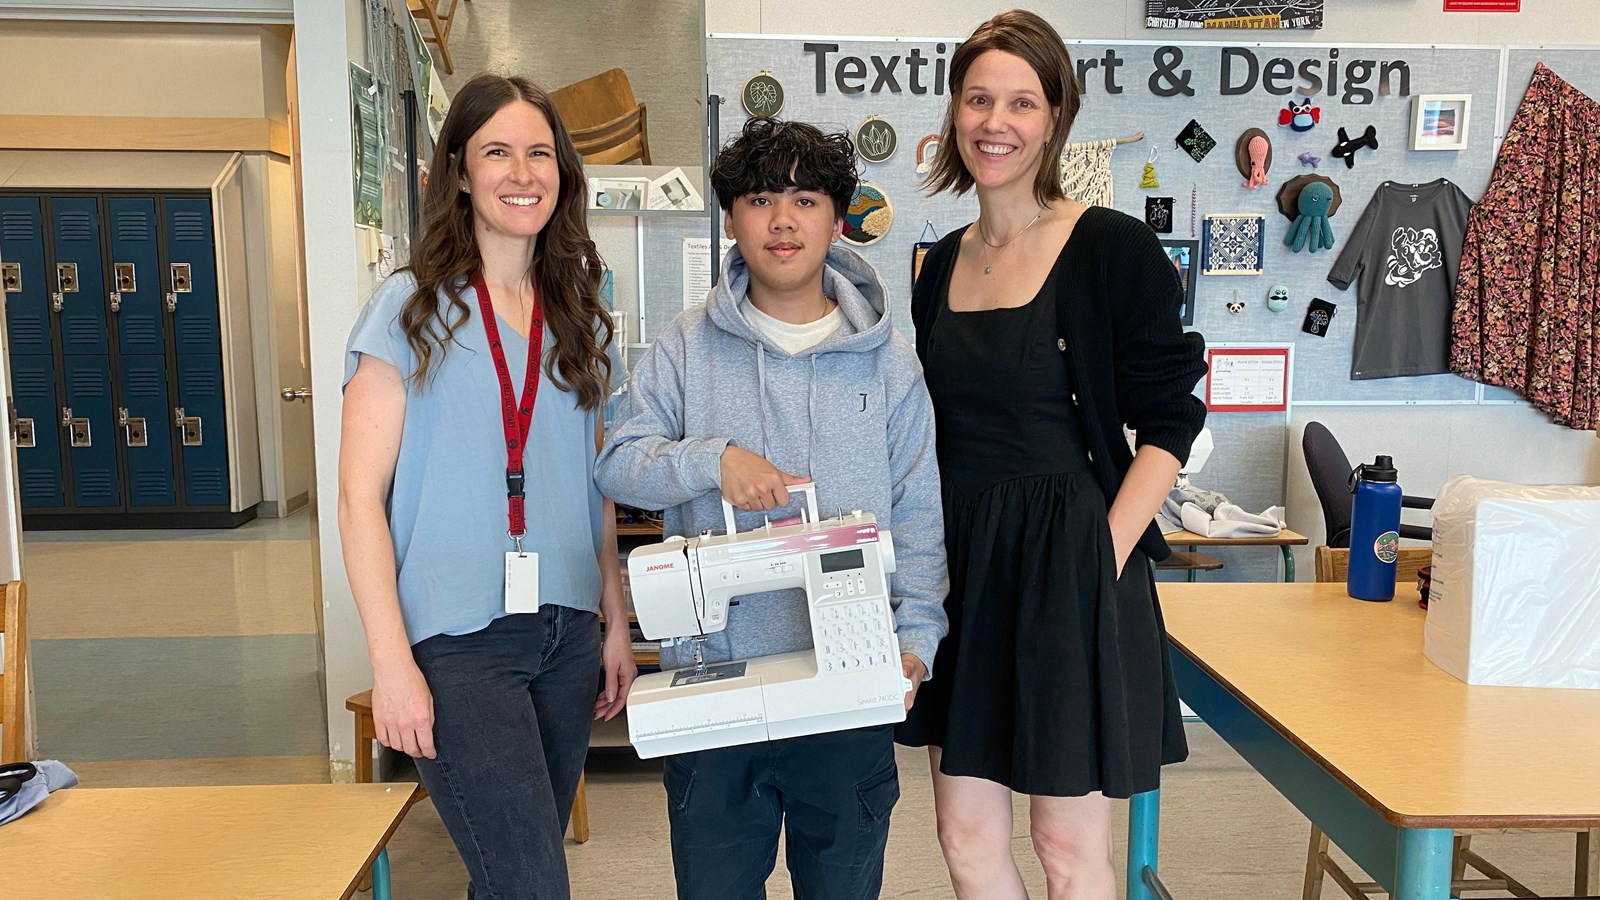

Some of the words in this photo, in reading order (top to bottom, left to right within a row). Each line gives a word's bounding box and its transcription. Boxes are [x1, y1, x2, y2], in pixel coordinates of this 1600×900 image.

[1147, 16, 1176, 28] CHRYSLER
[1206, 17, 1280, 29] MANHATTAN
[1291, 15, 1311, 27] YORK
[803, 42, 961, 95] Texti
[1076, 49, 1123, 94] rt
[1148, 46, 1195, 97] &
[1220, 47, 1410, 104] Design
[859, 393, 868, 412] J
[646, 562, 674, 572] JANOME
